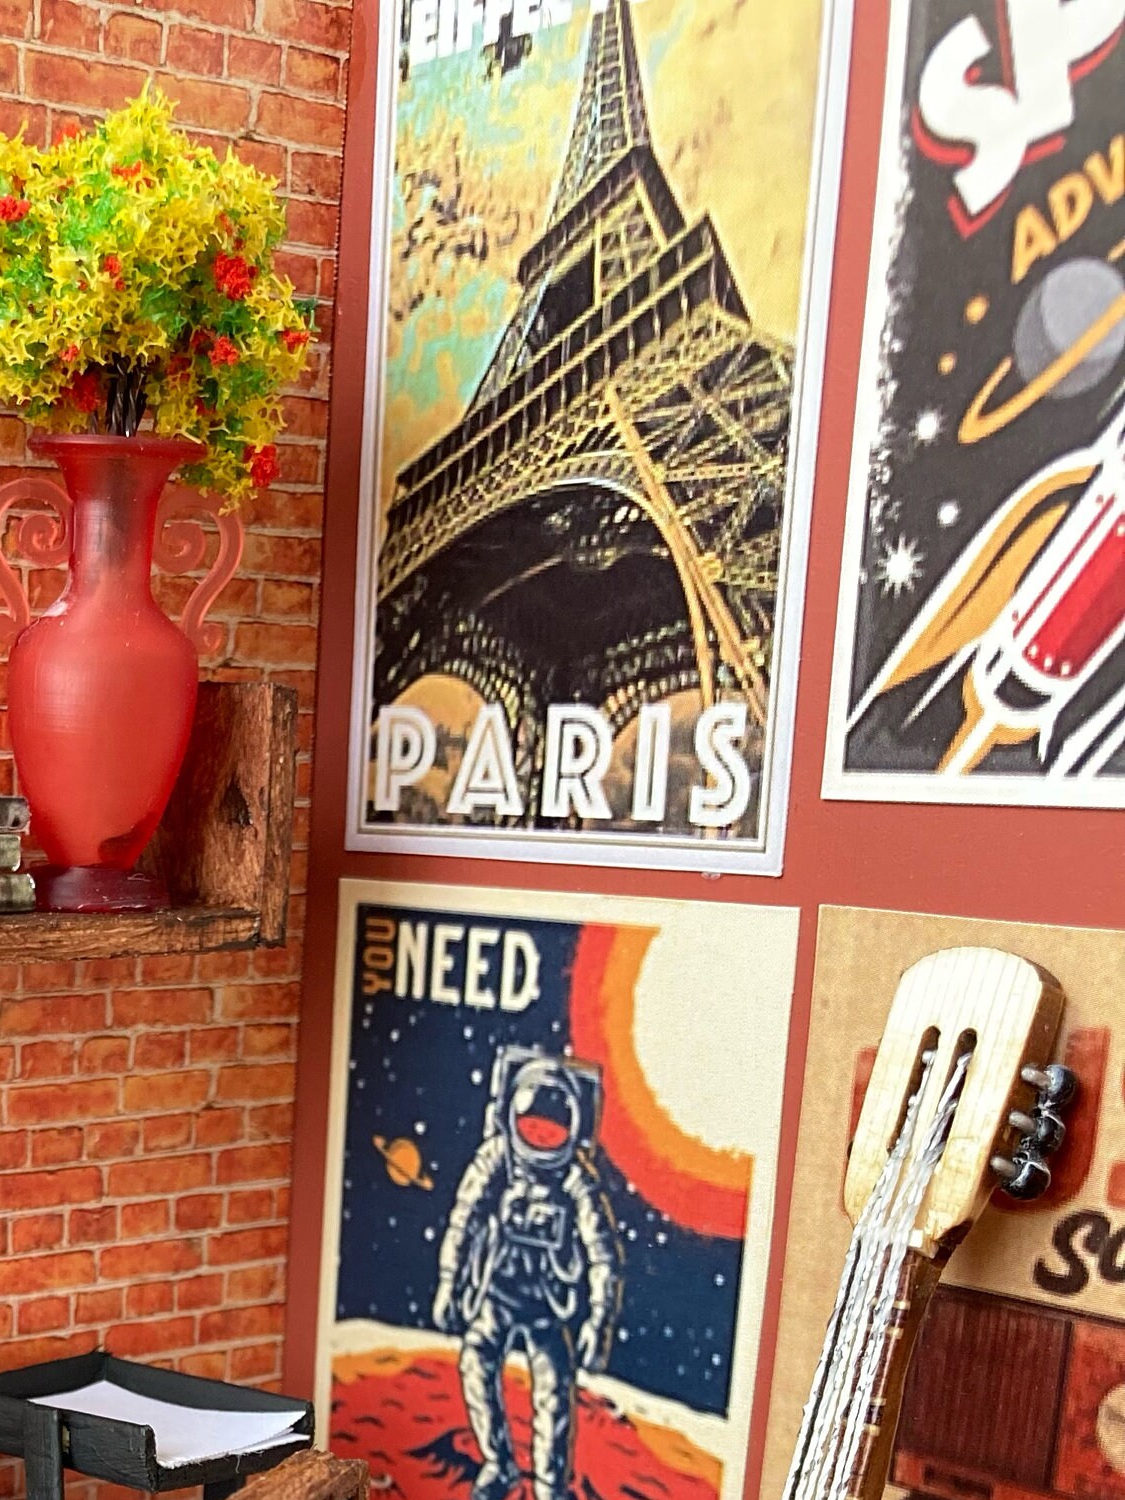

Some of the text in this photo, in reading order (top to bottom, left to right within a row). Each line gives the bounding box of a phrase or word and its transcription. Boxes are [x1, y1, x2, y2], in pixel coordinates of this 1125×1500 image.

[374, 701, 751, 829] PARIS
[362, 917, 397, 995] YOU
[394, 920, 542, 1013] NEED
